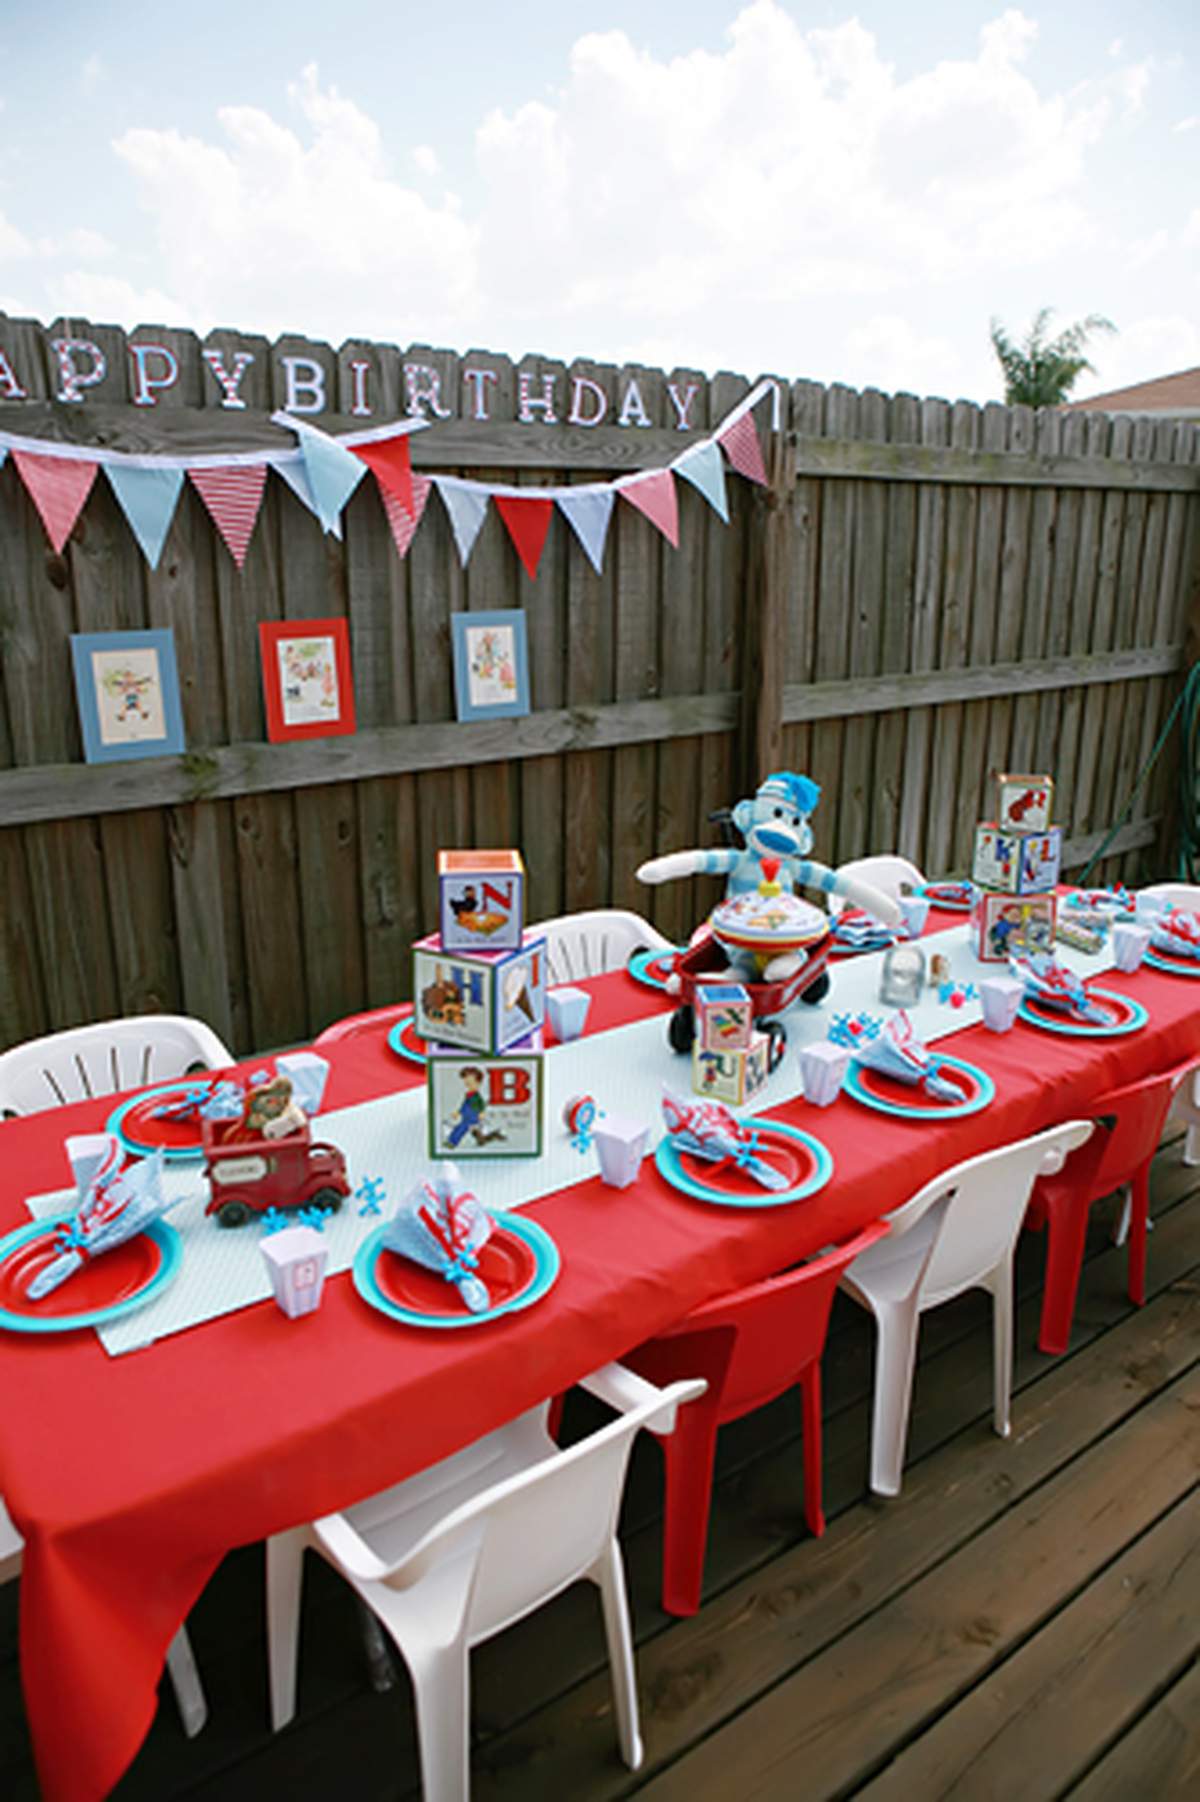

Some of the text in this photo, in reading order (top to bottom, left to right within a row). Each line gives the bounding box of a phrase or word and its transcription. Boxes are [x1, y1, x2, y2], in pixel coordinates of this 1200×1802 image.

[281, 356, 698, 430] BIRTHDAY
[480, 880, 514, 914] N
[450, 965, 485, 1006] H
[486, 1066, 532, 1106] B
